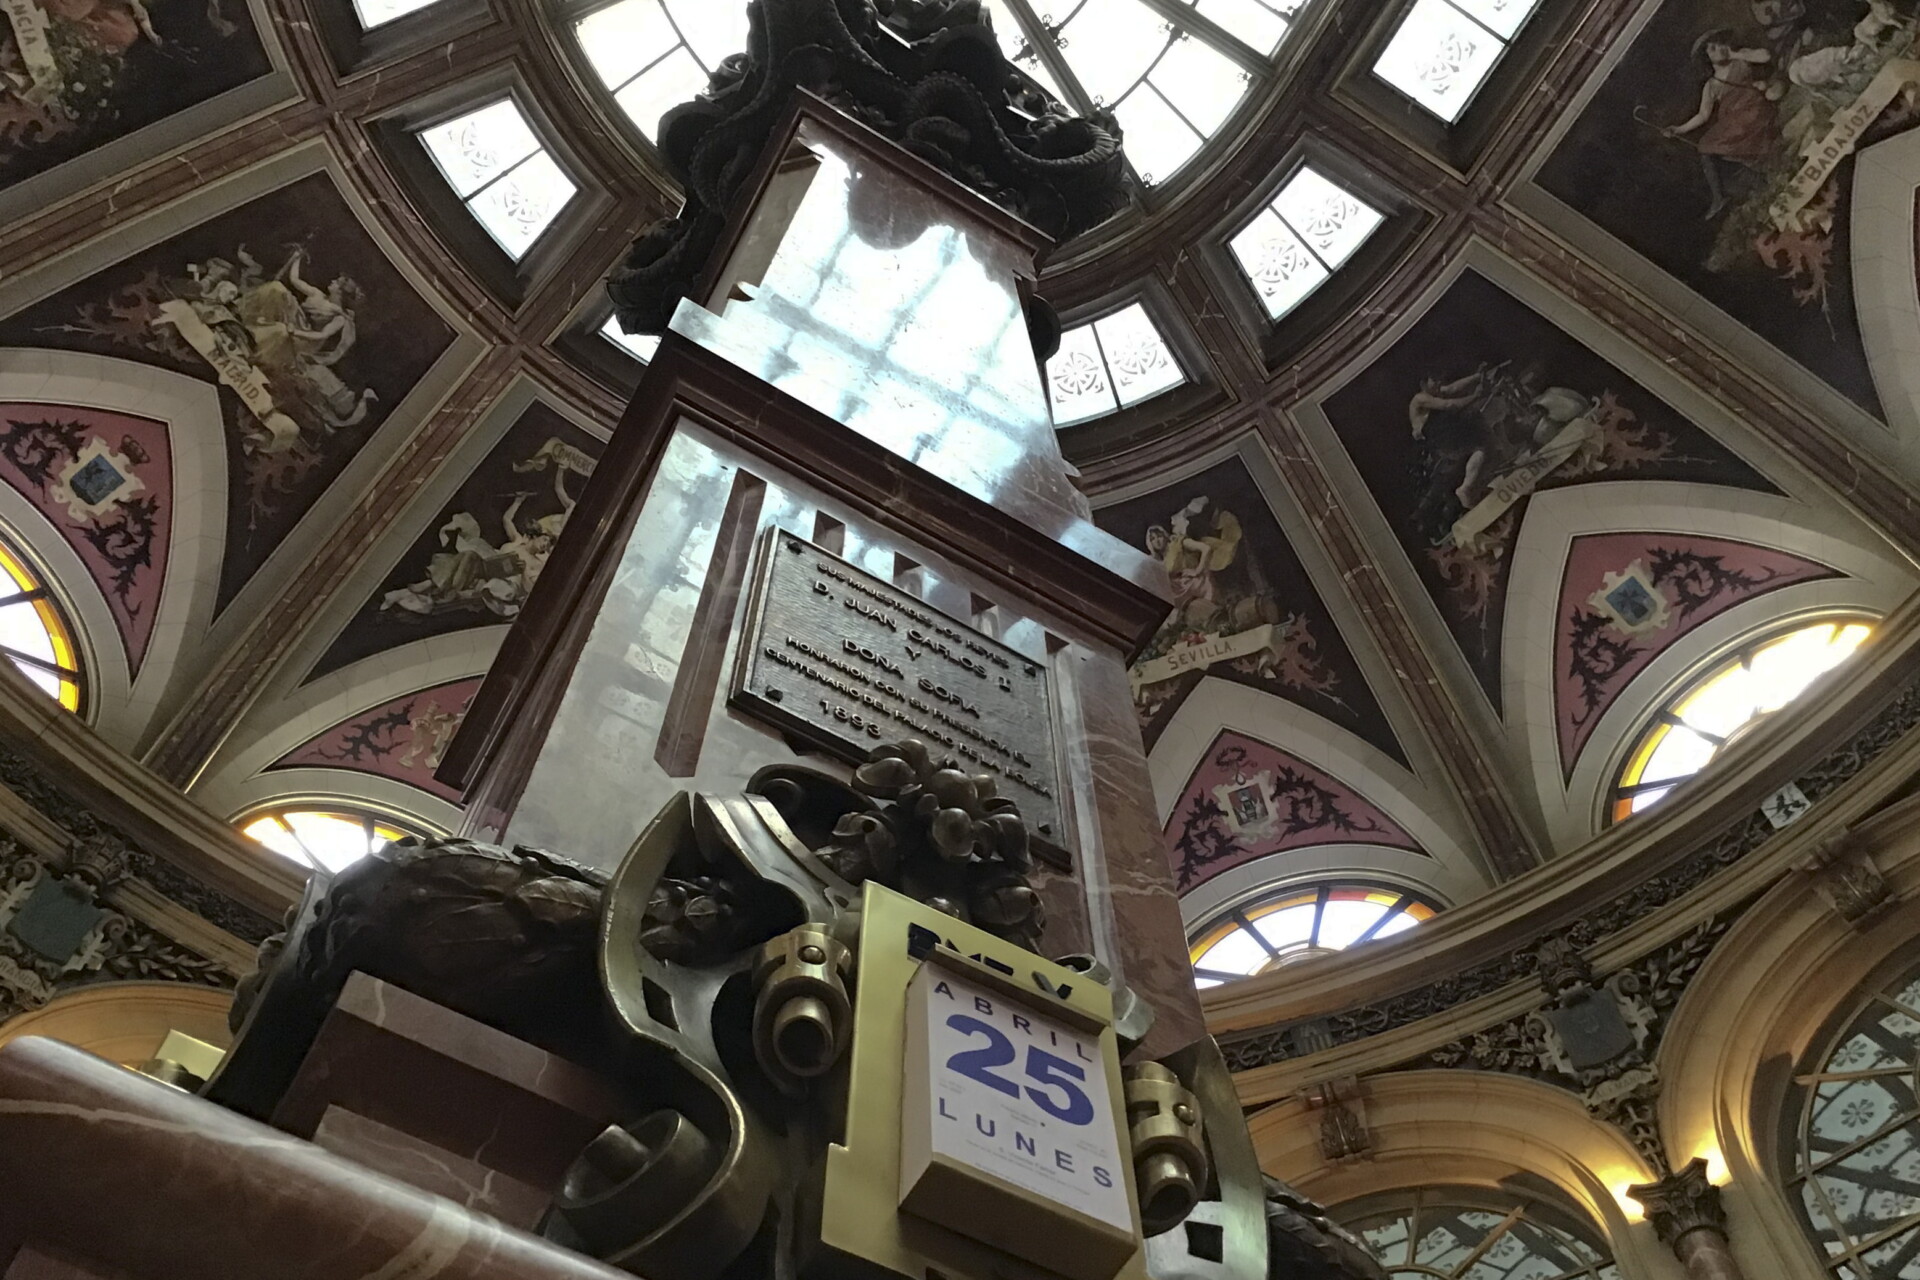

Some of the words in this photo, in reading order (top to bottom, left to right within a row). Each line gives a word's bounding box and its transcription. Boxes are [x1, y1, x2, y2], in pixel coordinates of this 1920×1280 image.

[813, 580, 834, 600] D.
[844, 598, 897, 632] JUAN
[908, 628, 987, 679] CARLOS
[817, 562, 846, 582] SUS
[846, 577, 932, 629] MAJESTADES
[935, 624, 961, 643] LOS
[965, 640, 1009, 669] REYES
[904, 645, 921, 661] Y
[764, 646, 860, 699] CENTENARIO
[862, 693, 890, 717] DEL
[894, 709, 954, 749] PALACIO
[958, 742, 978, 762] DE
[980, 754, 1000, 772] LA
[1004, 766, 1052, 800] BOLSA
[786, 636, 870, 684] HONRARON
[873, 679, 905, 703] CON
[909, 697, 930, 714] SU
[933, 708, 1010, 757] PRESENCIA
[1013, 750, 1032, 768] EL
[819, 699, 881, 739] 1893
[934, 980, 1094, 1064] ABRIL
[945, 1013, 1095, 1126] 25
[938, 1097, 1113, 1188] LUNES
